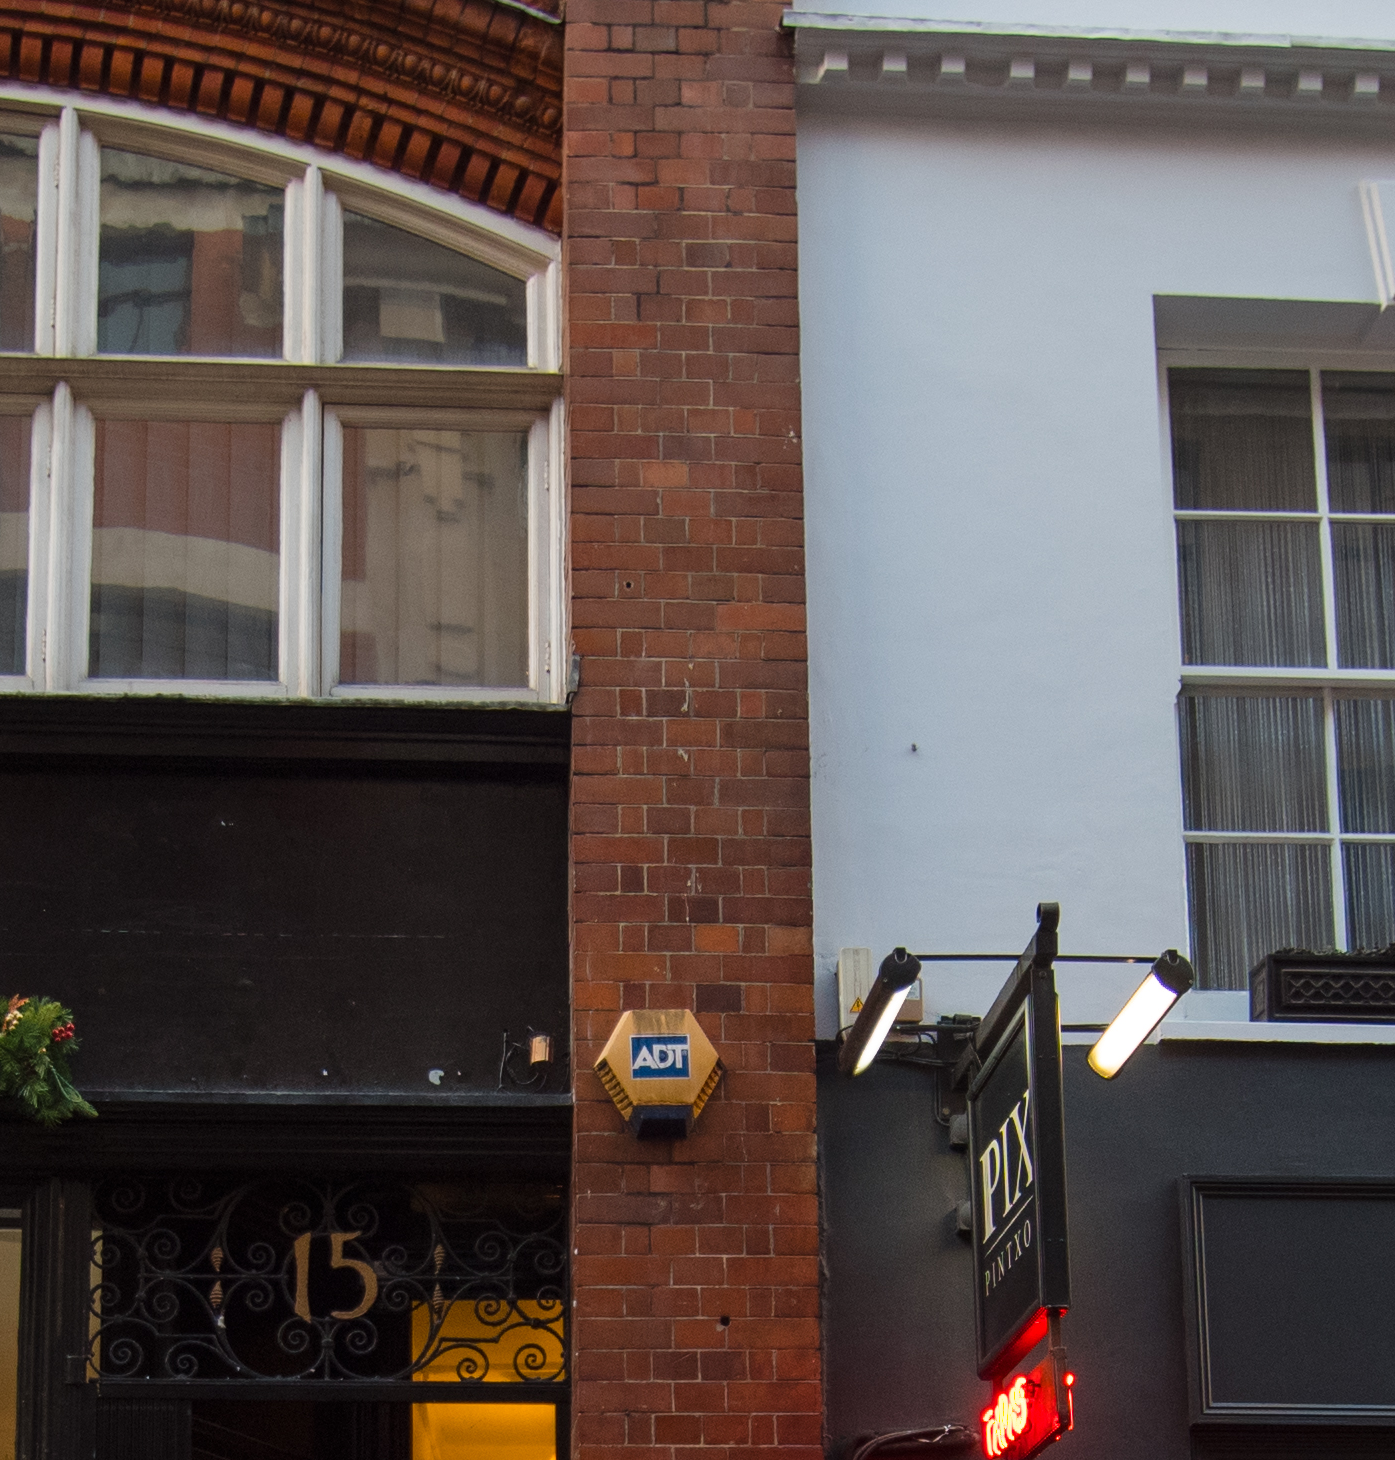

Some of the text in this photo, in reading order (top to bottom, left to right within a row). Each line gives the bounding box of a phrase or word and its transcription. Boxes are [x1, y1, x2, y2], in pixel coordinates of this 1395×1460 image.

[632, 1044, 688, 1070] ADT
[979, 1088, 1034, 1245] PIX
[294, 1231, 378, 1324] 15
[984, 1219, 1032, 1297] PINTXO
